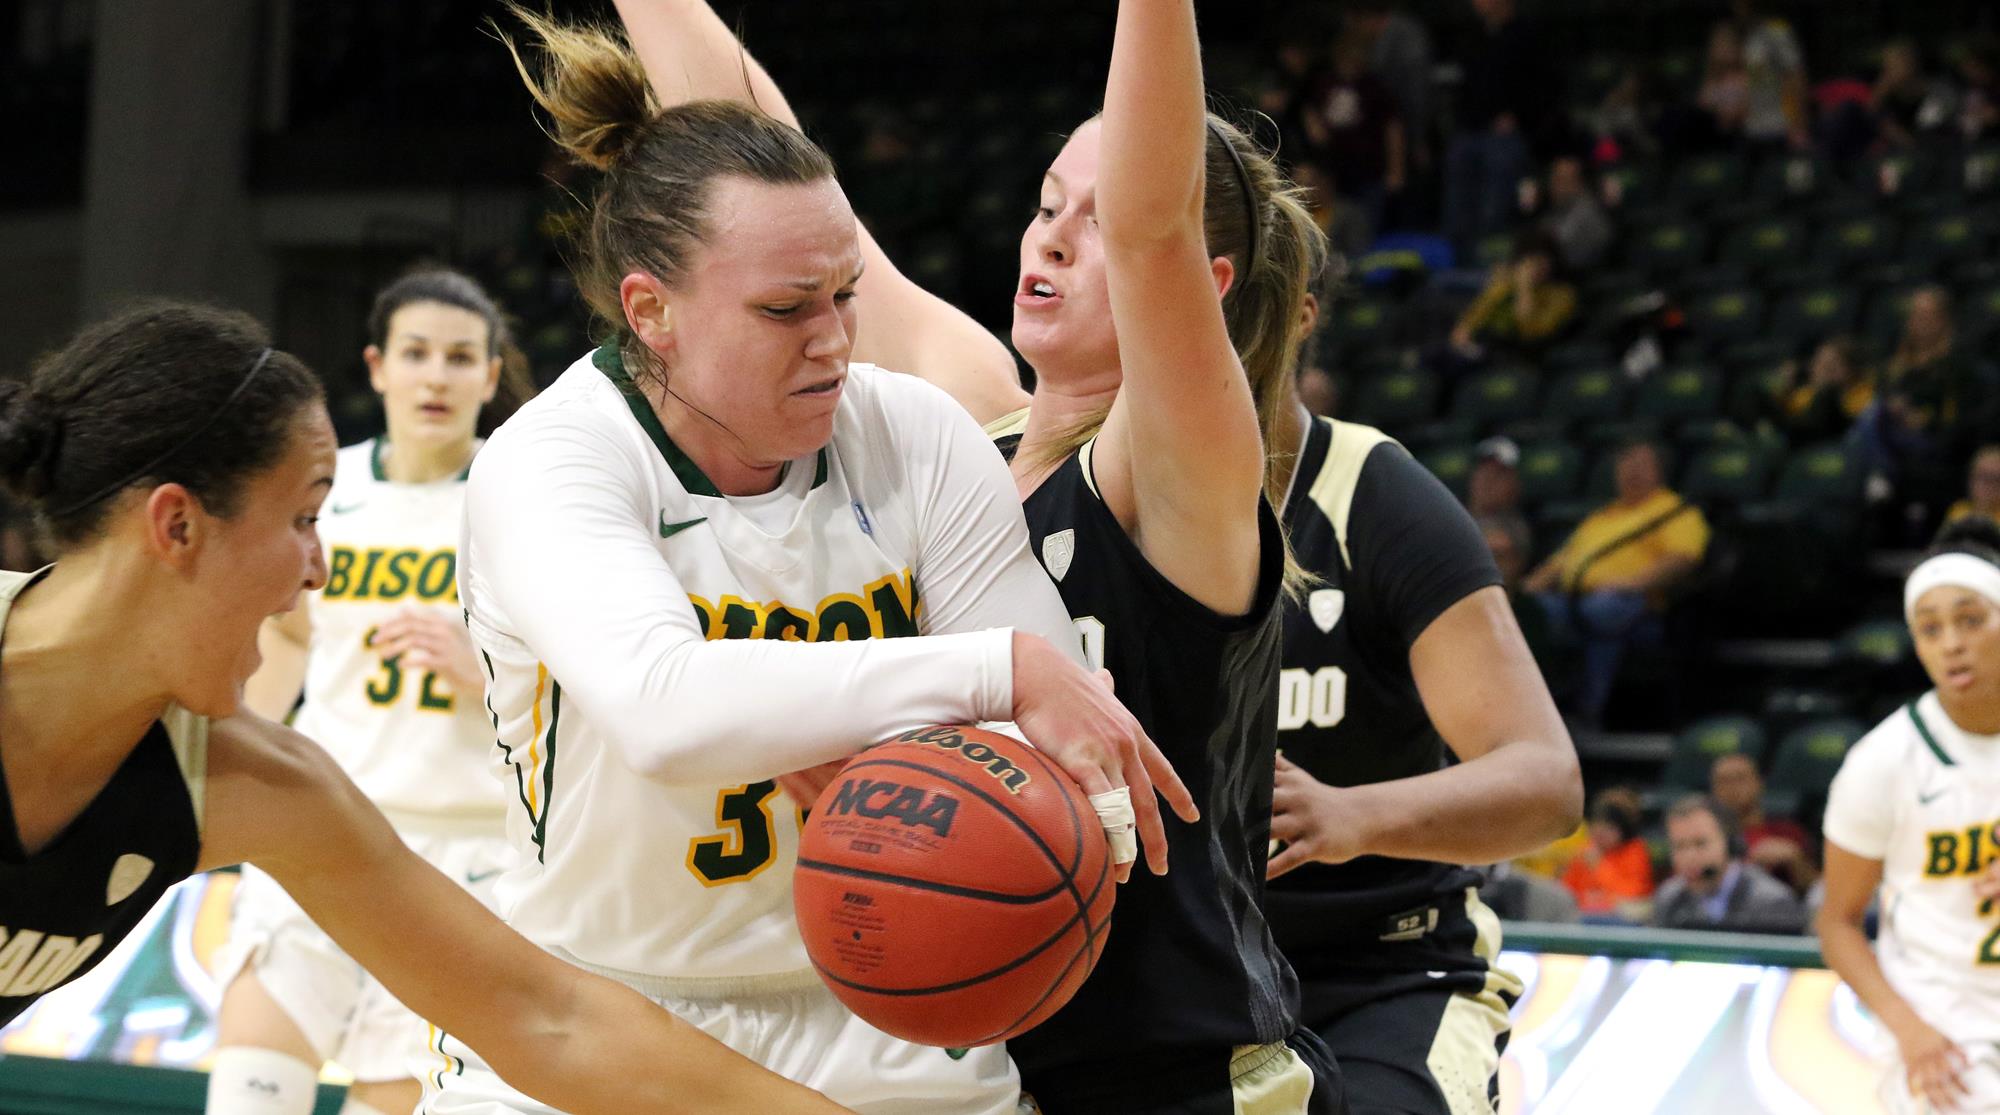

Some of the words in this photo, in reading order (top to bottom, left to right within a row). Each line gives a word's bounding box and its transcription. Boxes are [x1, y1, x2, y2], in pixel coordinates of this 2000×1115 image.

[322, 545, 459, 604] BISO
[684, 779, 812, 888] 3
[825, 779, 961, 838] NCAA
